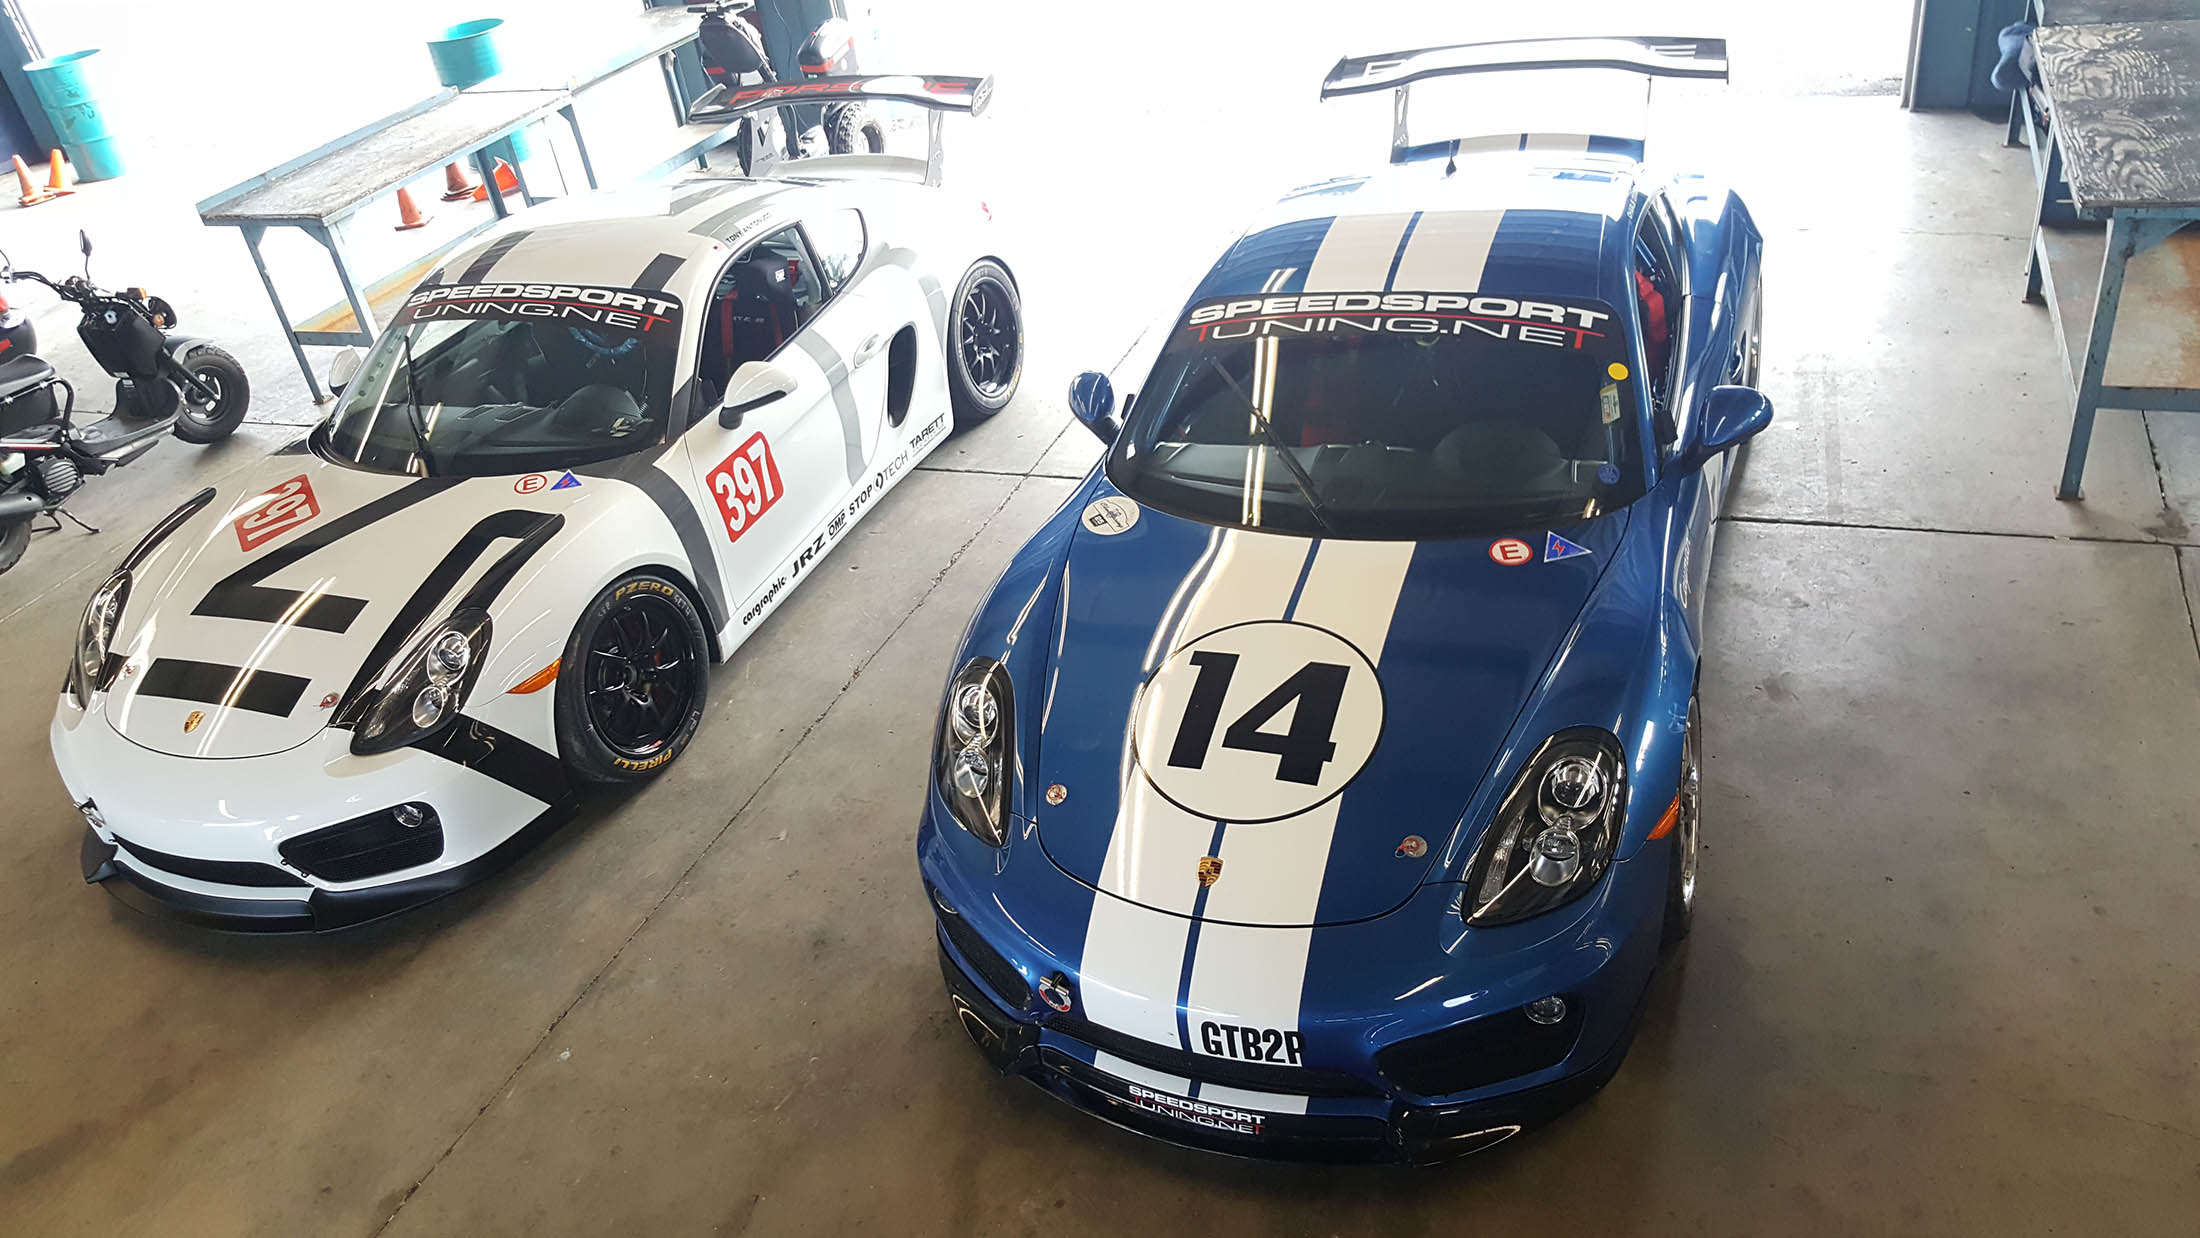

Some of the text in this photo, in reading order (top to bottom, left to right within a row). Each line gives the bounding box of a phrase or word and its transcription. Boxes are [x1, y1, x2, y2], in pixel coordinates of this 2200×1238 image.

[726, 229, 743, 244] TONY
[408, 284, 679, 316] SPEEDSPORT
[1190, 294, 1609, 329] SPEEDSPORT
[1188, 313, 1605, 349] TUNING.NET
[909, 412, 945, 449] TARETT
[714, 437, 775, 532] 397
[242, 481, 313, 542] 397
[742, 576, 786, 626] cargraphic
[792, 532, 826, 578] JRZ
[828, 511, 847, 538] OMP
[1167, 650, 1351, 786] 14
[614, 748, 673, 771] PIRELLI
[1201, 1020, 1306, 1064] GTB2P
[1128, 1085, 1266, 1125] SPEEDSPORT
[1130, 1096, 1265, 1135] TUNING.NET
